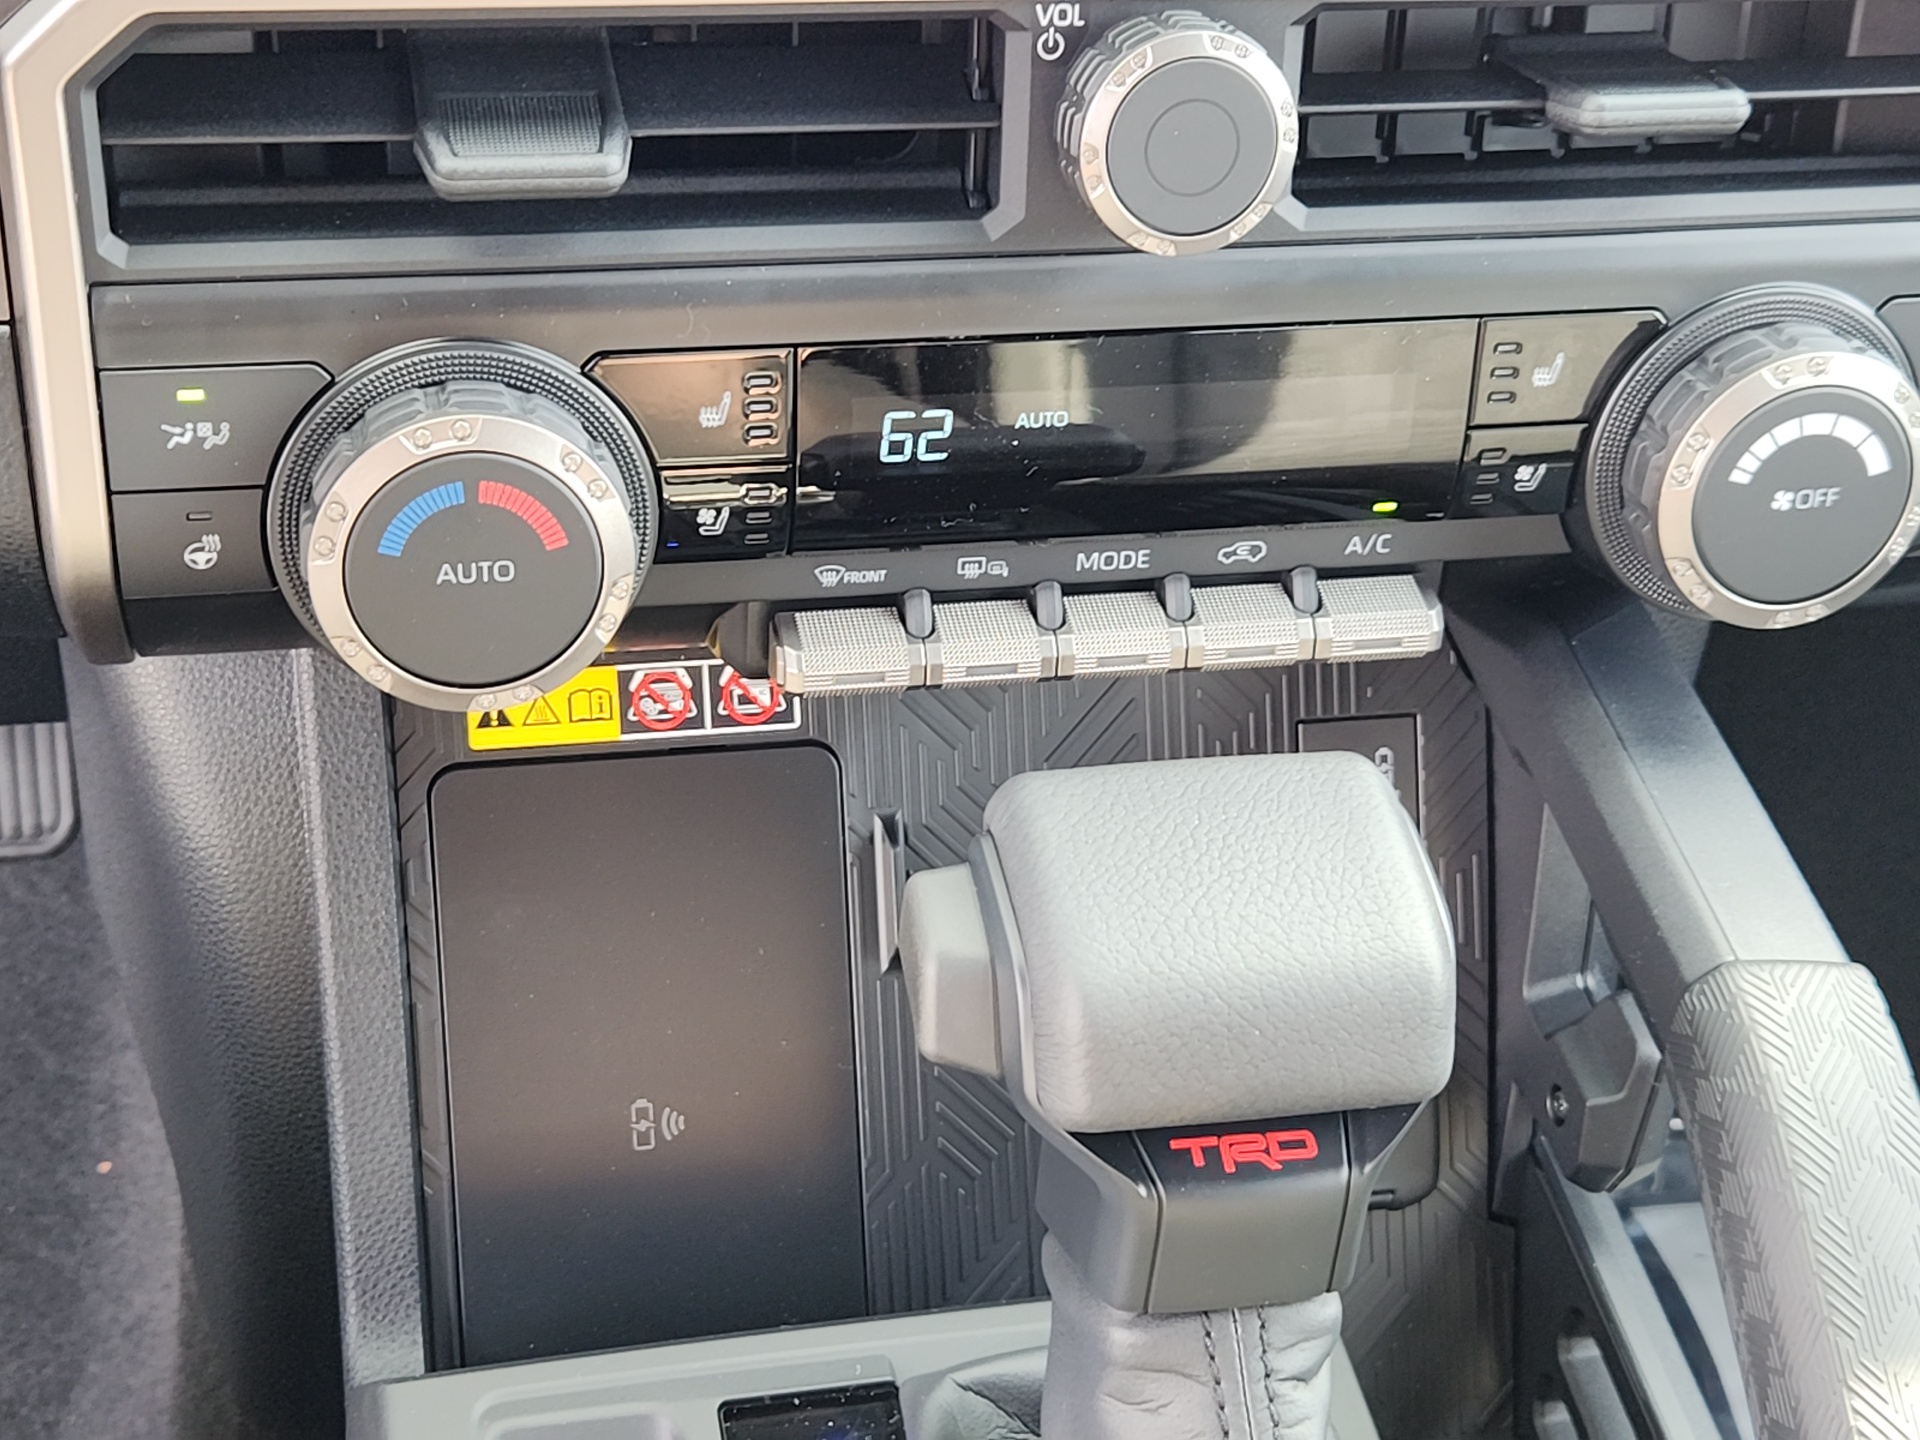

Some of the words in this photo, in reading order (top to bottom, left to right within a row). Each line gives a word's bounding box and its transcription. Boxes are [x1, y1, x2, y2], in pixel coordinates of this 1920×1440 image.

[1035, 3, 1085, 27] VOL
[1015, 411, 1069, 429] AUTO
[880, 409, 954, 463] 62
[1795, 487, 1841, 510] OFF
[1344, 533, 1392, 555] A/C
[436, 560, 515, 585] AUTO
[1076, 550, 1151, 572] MODE
[843, 569, 887, 584] FRONT
[1169, 1129, 1319, 1174] TRD
